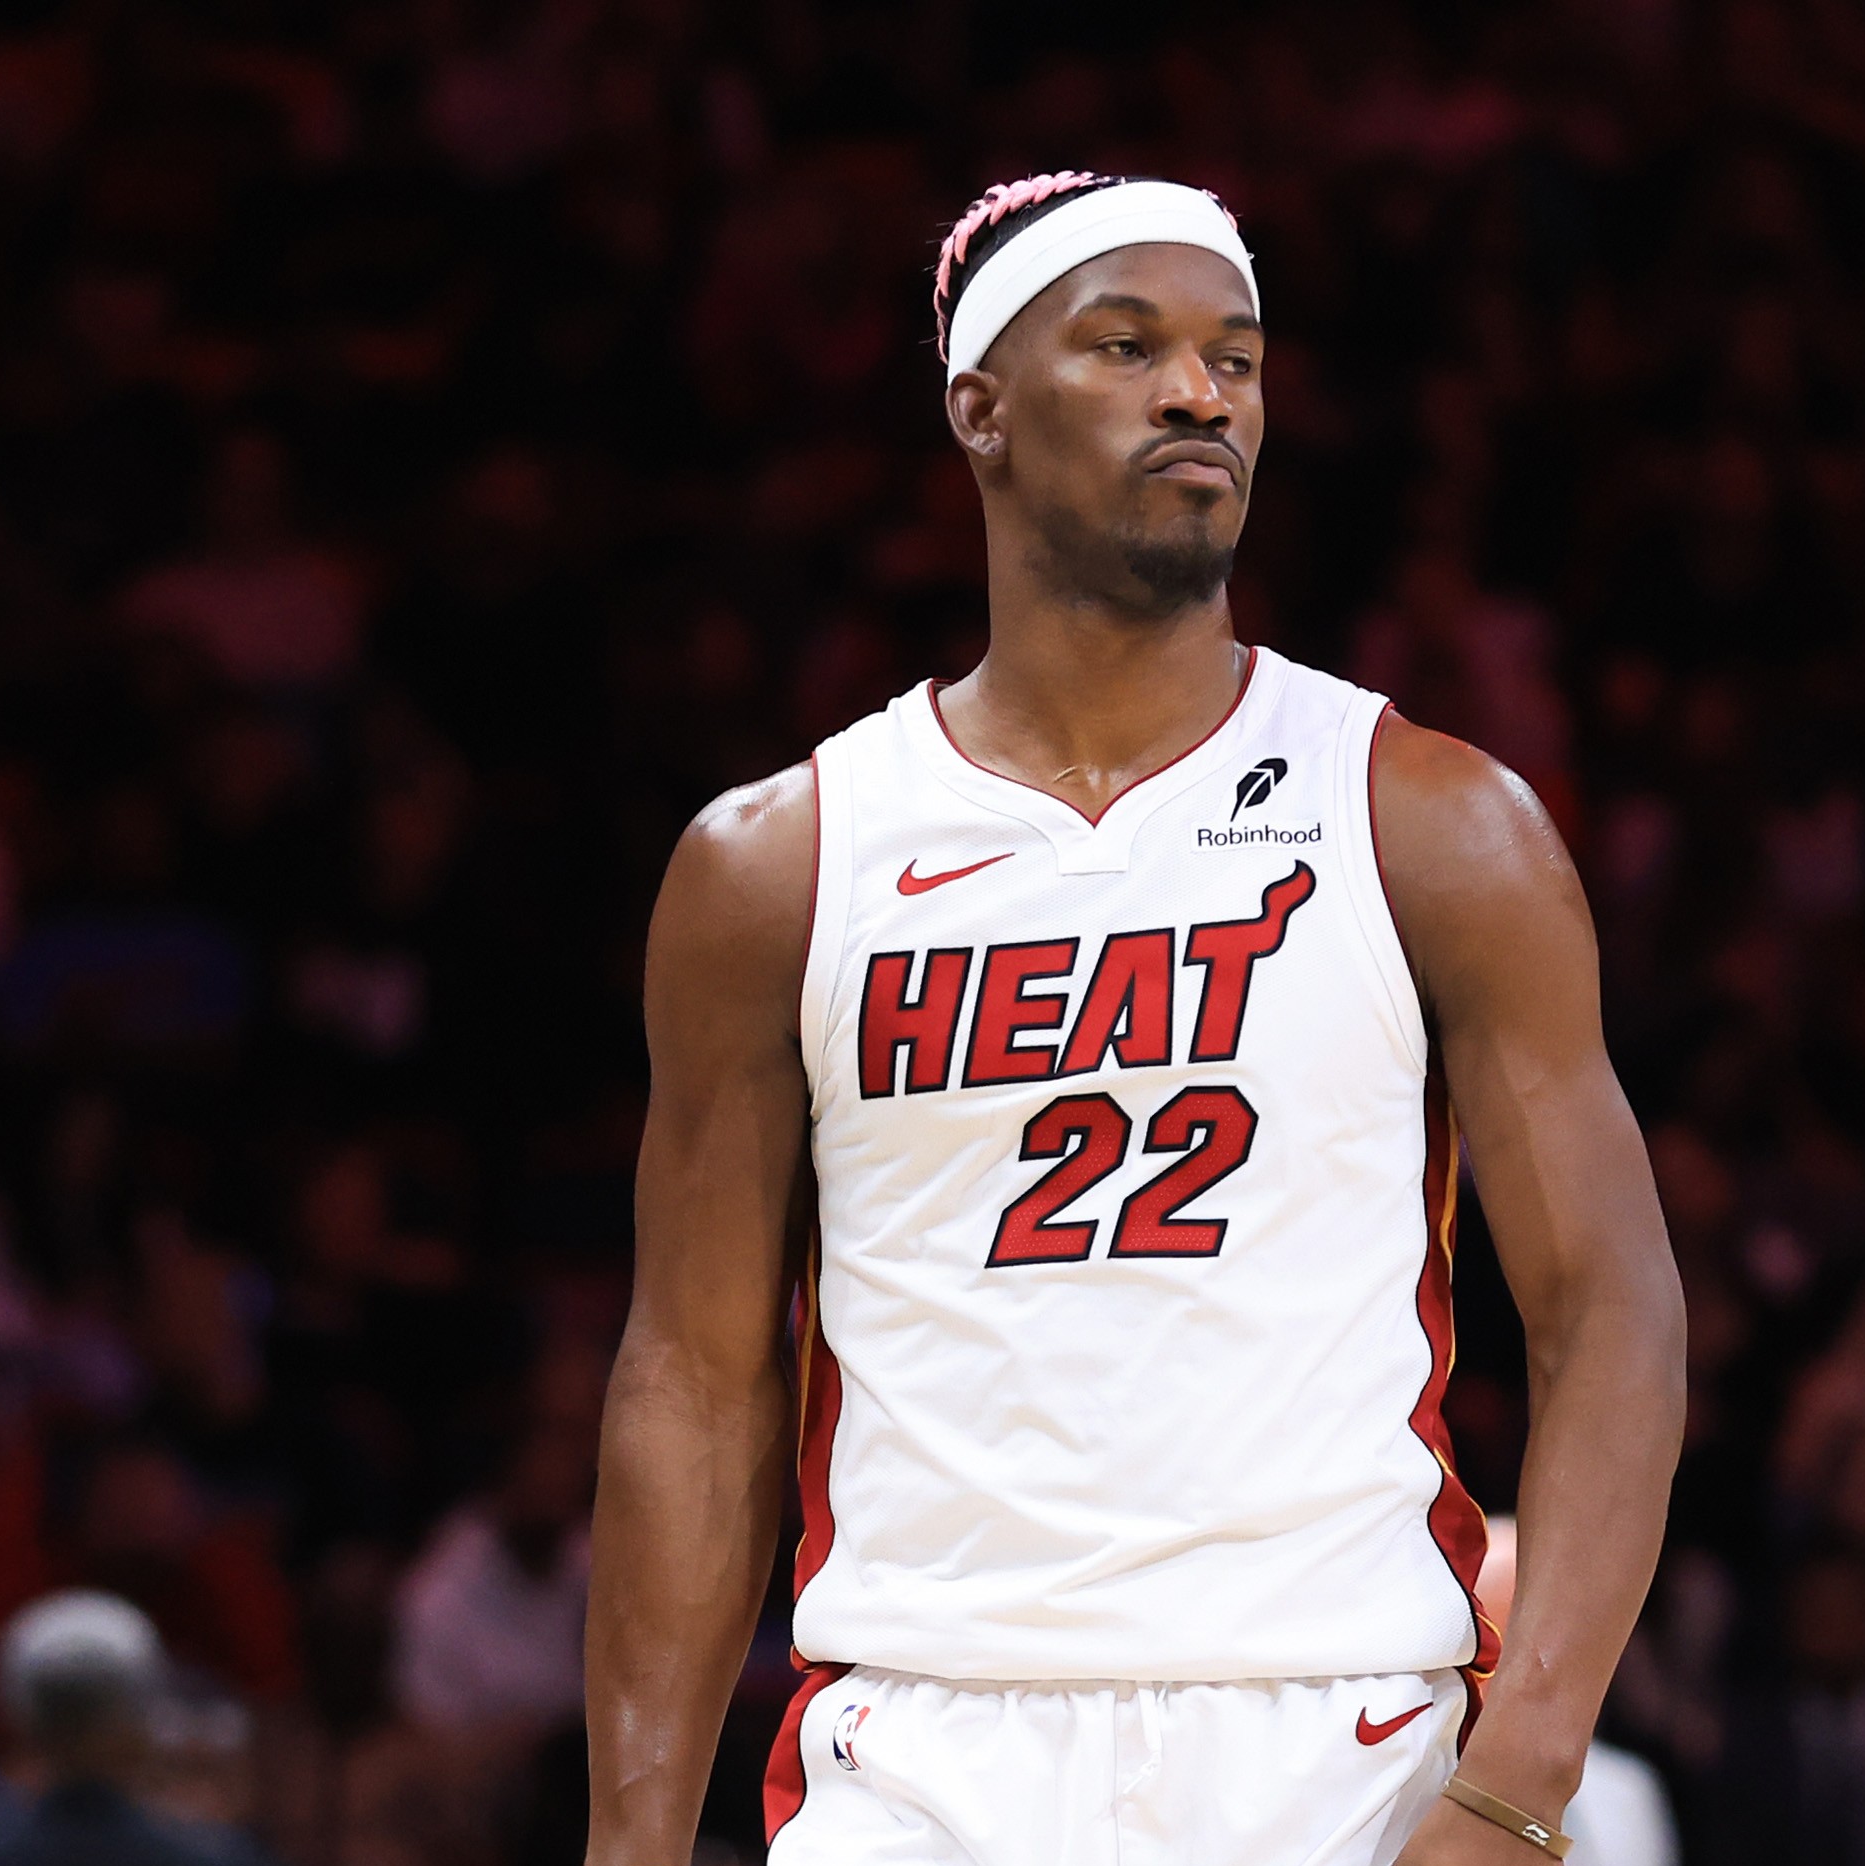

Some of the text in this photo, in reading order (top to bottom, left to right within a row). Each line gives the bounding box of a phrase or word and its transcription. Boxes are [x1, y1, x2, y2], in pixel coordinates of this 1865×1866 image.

[1197, 822, 1322, 847] Robinhood
[857, 859, 1317, 1101] HEAT
[984, 1084, 1259, 1269] 22
